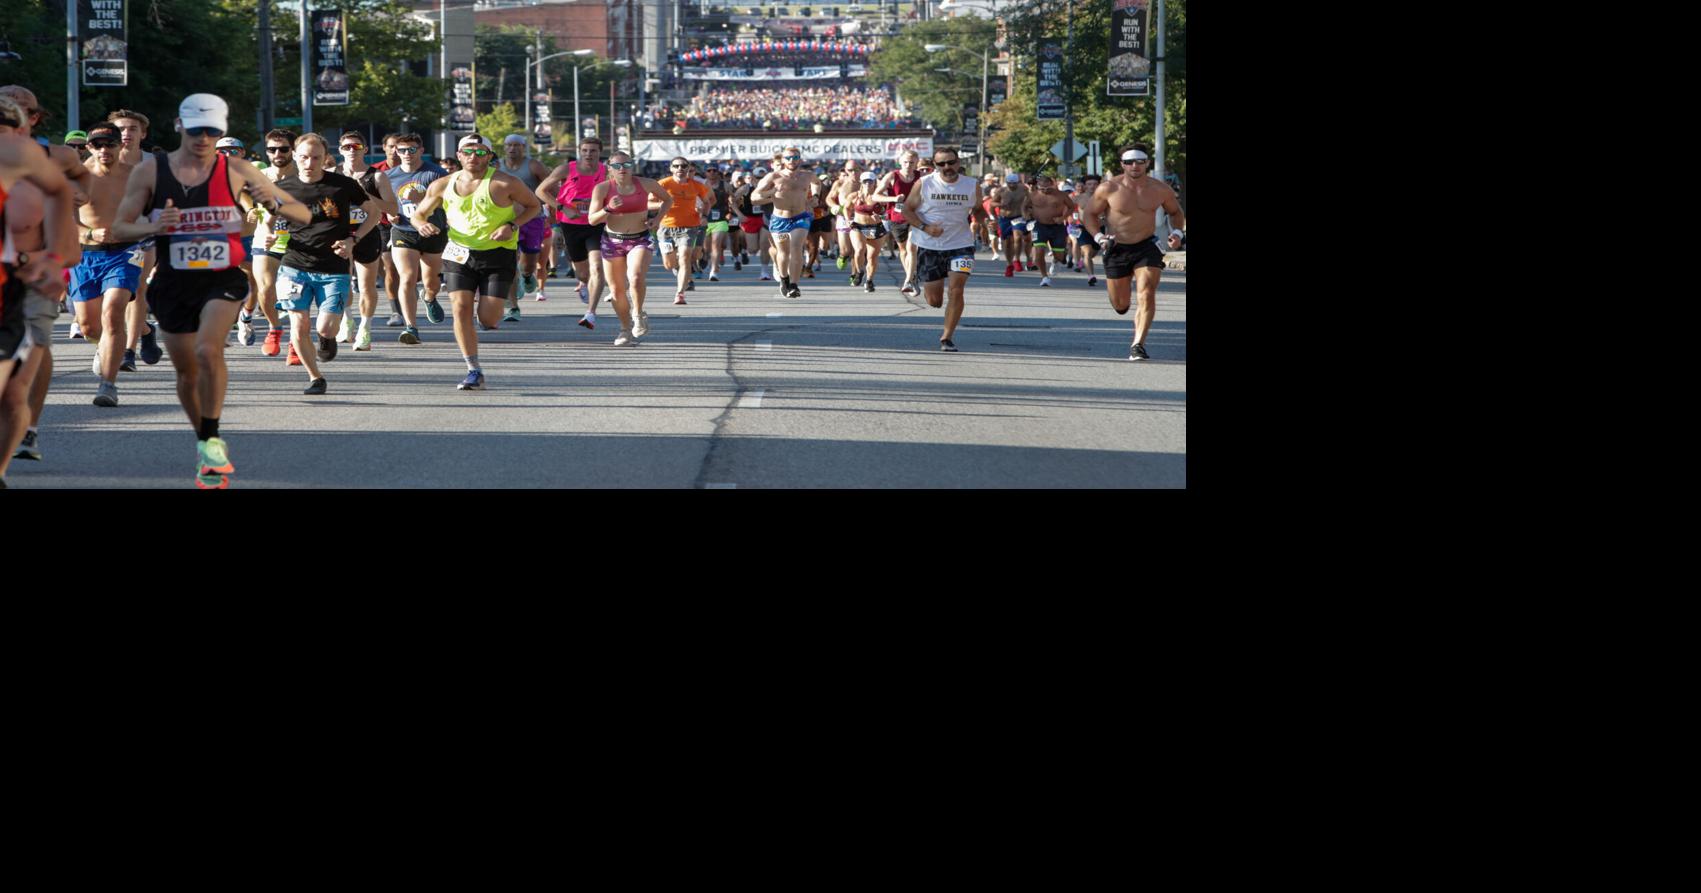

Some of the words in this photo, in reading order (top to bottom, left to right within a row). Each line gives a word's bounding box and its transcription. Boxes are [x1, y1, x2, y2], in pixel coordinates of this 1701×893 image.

[91, 0, 121, 9] WITH
[95, 10, 117, 19] THE
[89, 20, 122, 29] BEST!
[824, 144, 881, 154] DEALERS
[177, 246, 224, 261] 1342
